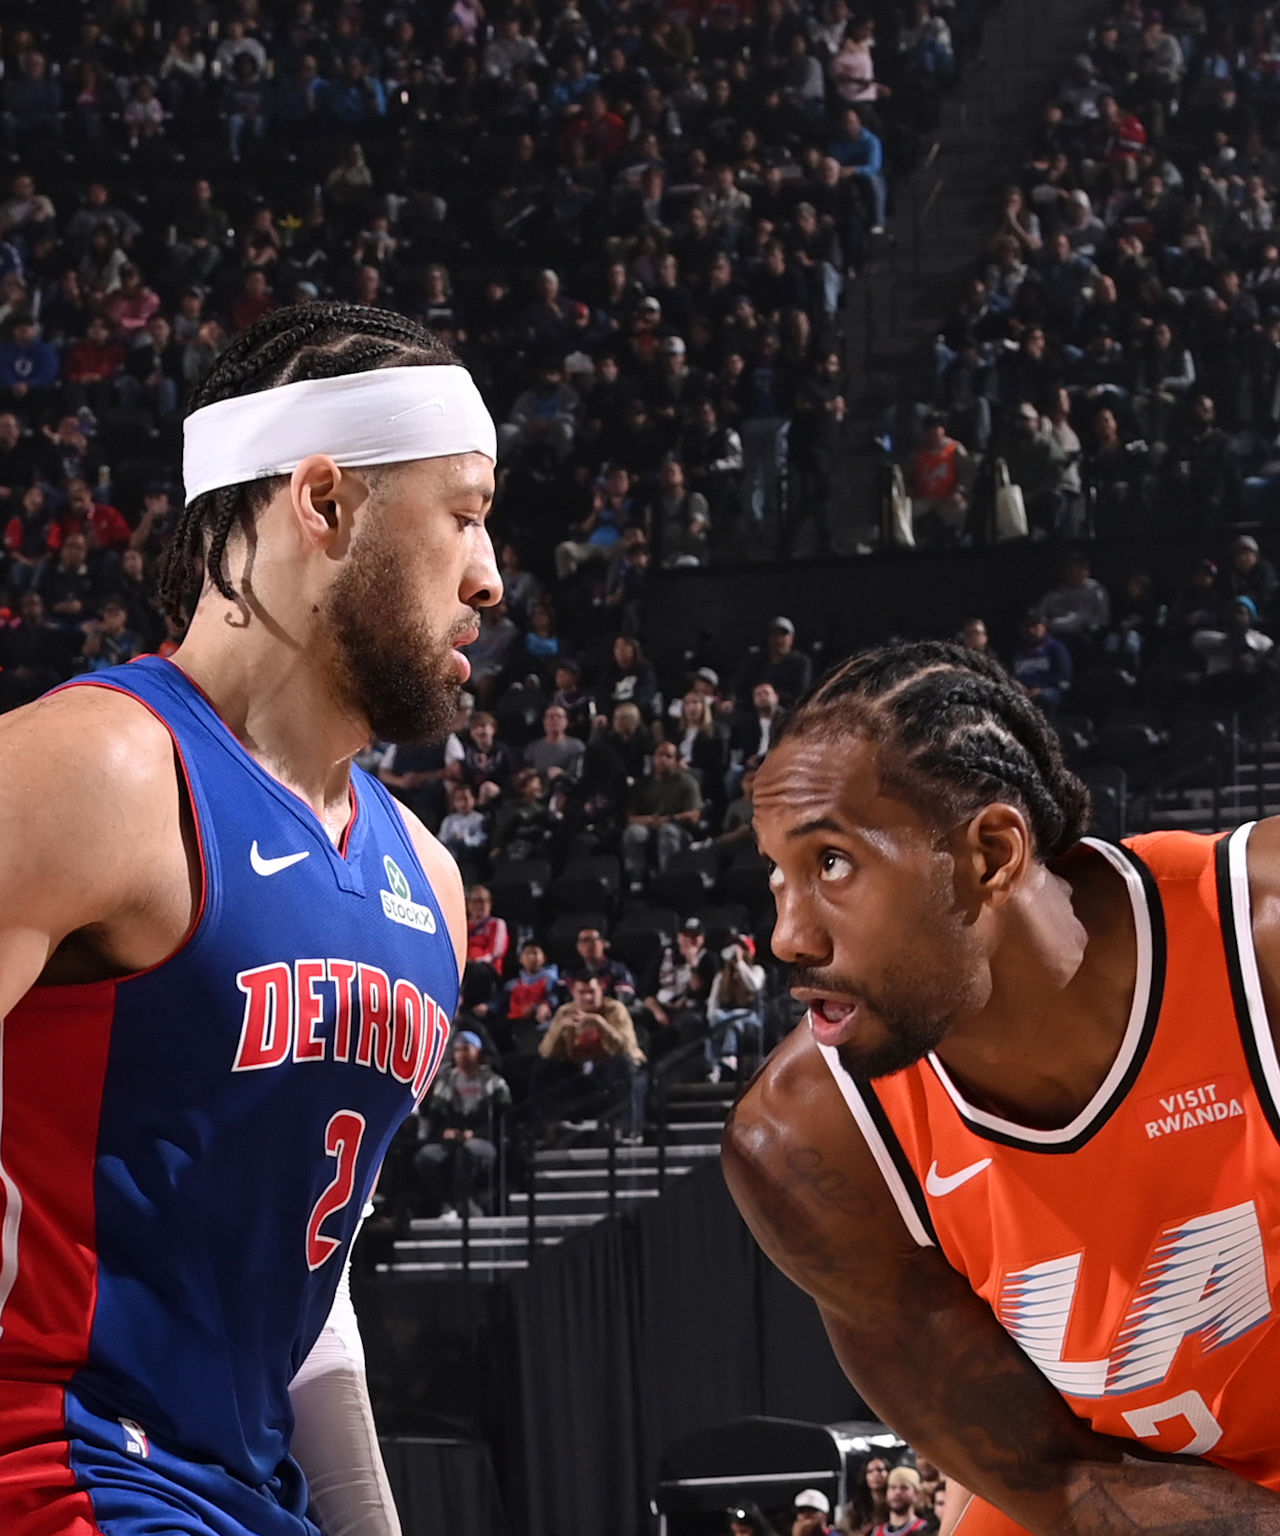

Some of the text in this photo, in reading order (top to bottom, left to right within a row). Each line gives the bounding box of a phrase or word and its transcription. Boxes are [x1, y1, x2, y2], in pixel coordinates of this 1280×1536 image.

[383, 894, 434, 930] StockX
[231, 958, 451, 1114] DETROIT
[1145, 1099, 1244, 1139] RWANDA
[1159, 1084, 1216, 1113] VISIT
[305, 1109, 366, 1272] 2
[999, 1199, 1272, 1398] LA
